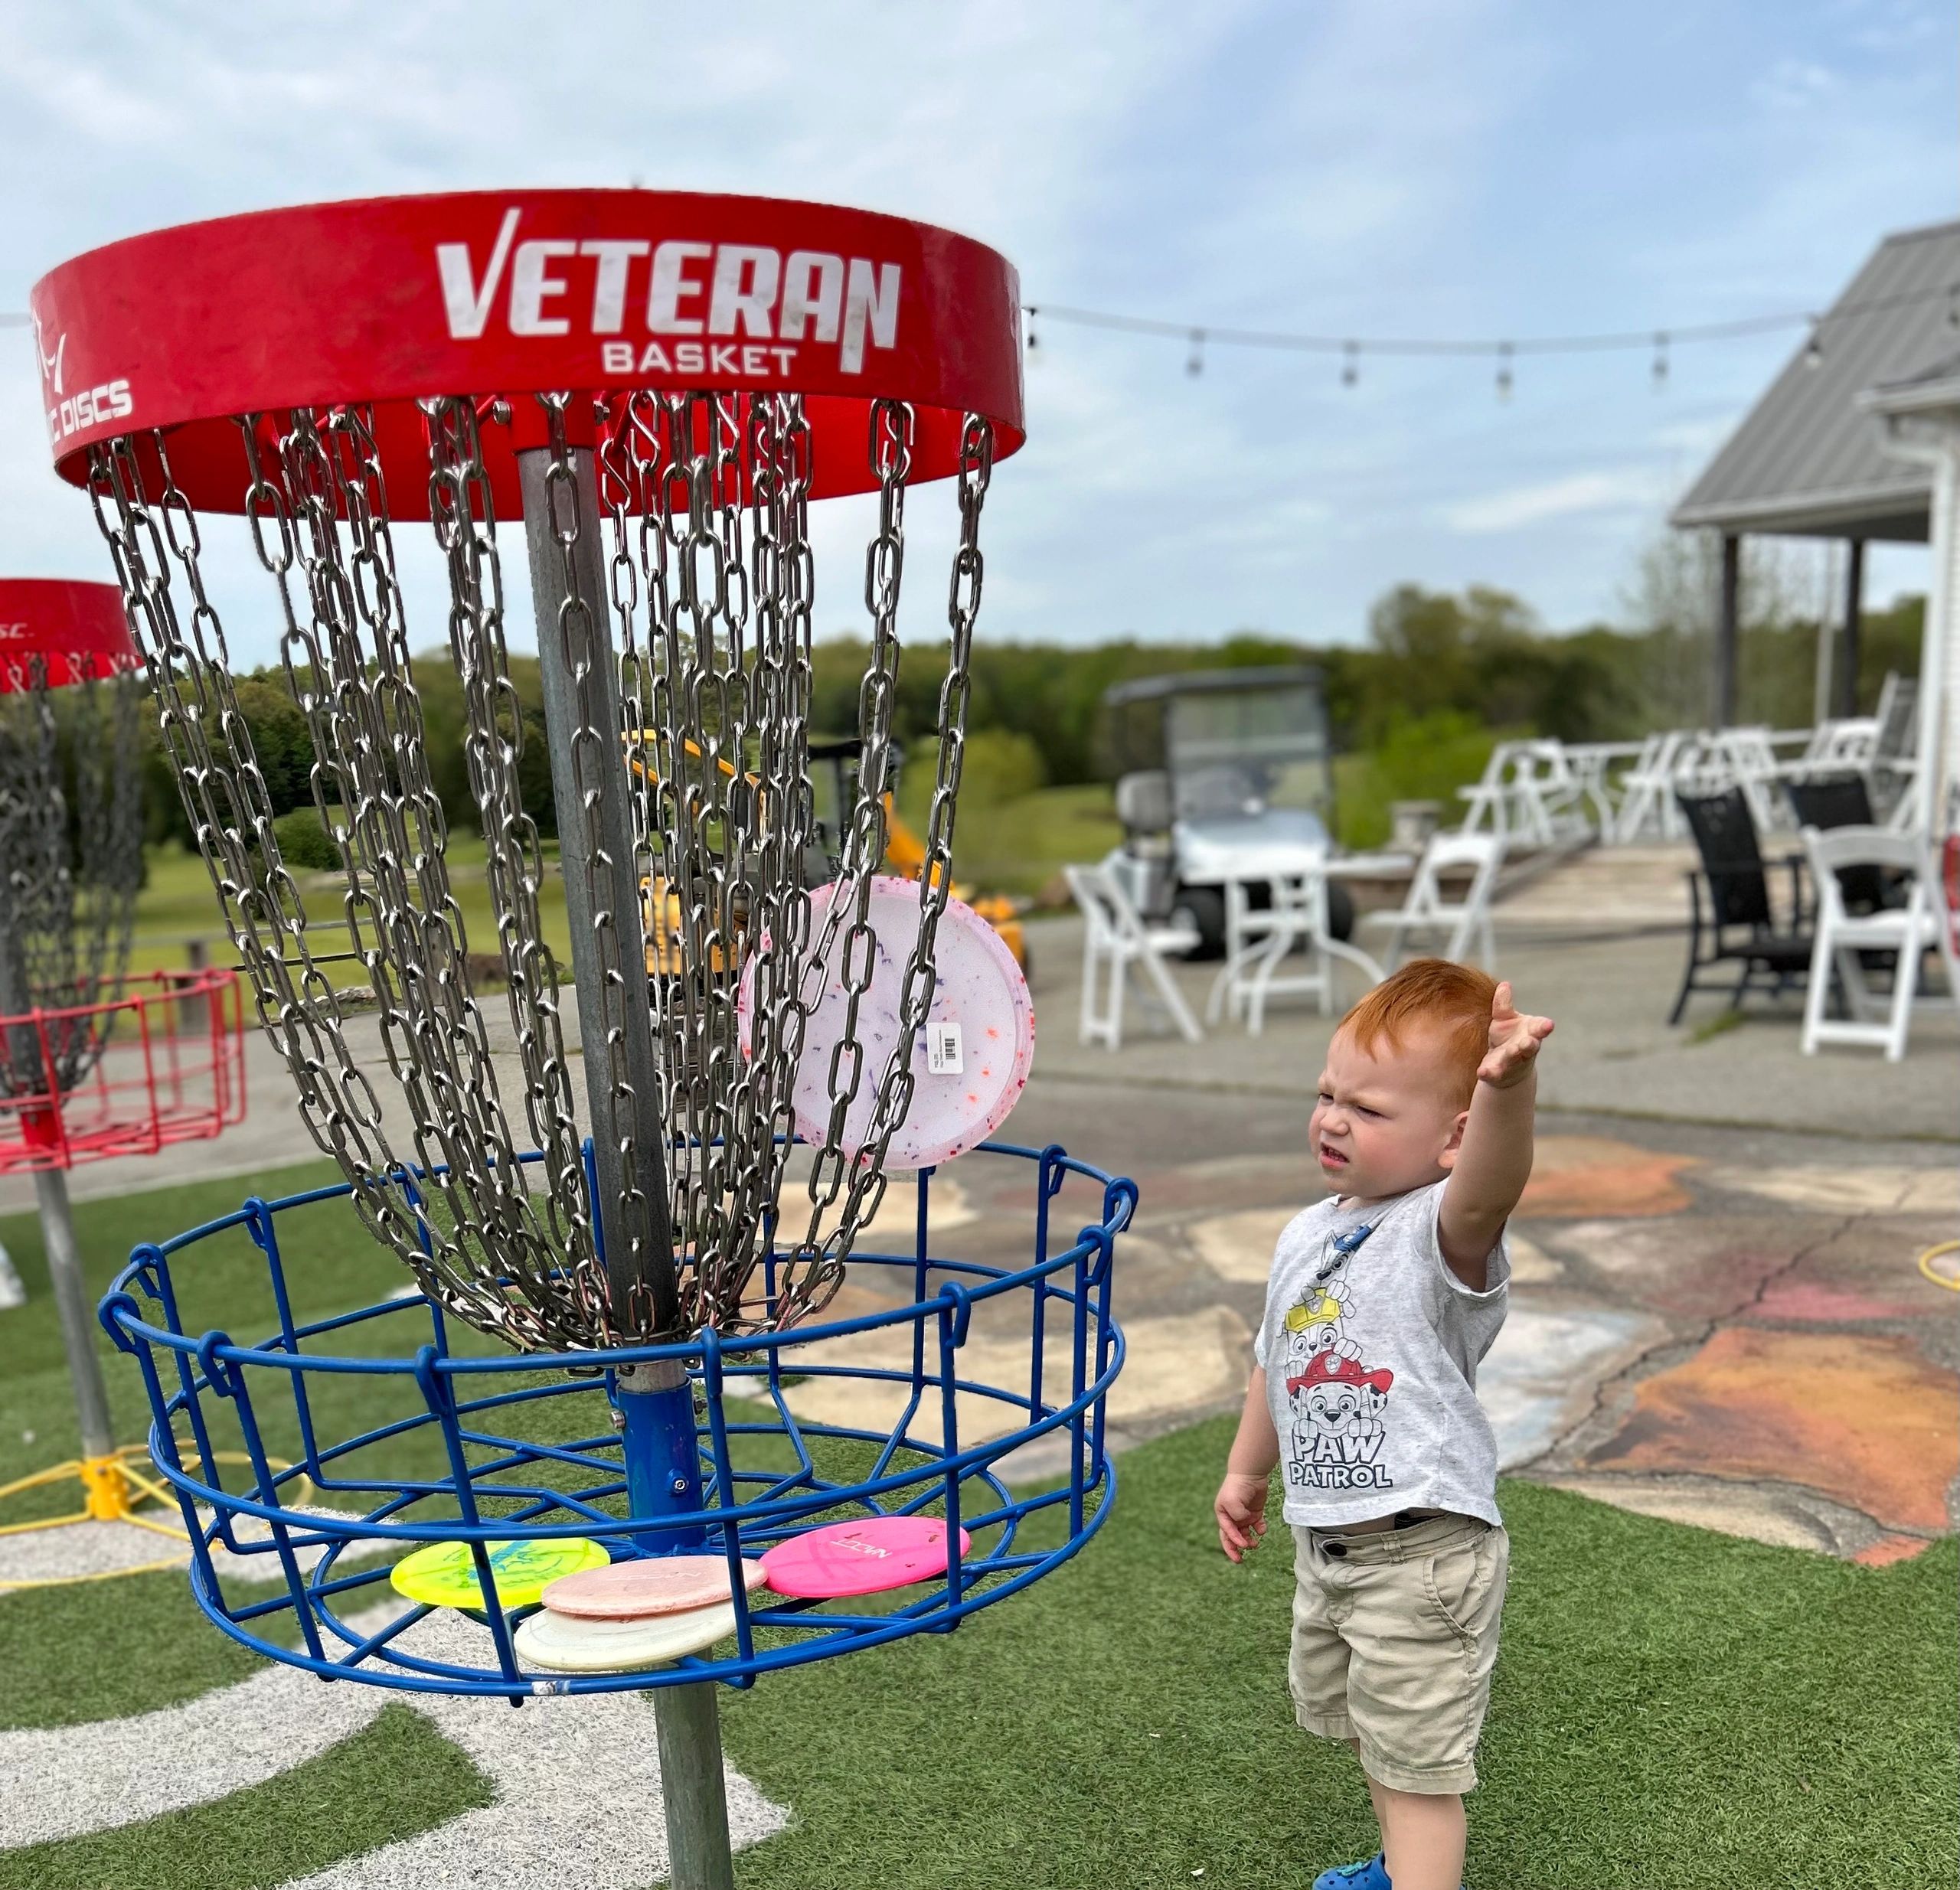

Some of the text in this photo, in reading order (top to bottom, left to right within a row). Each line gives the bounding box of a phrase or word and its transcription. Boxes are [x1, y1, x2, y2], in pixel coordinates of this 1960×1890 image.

[436, 207, 902, 374] VETERAN
[601, 341, 797, 377] BASKET
[60, 379, 133, 437] DISCS
[1292, 1428, 1387, 1465] PAW
[1289, 1461, 1393, 1490] PATROL
